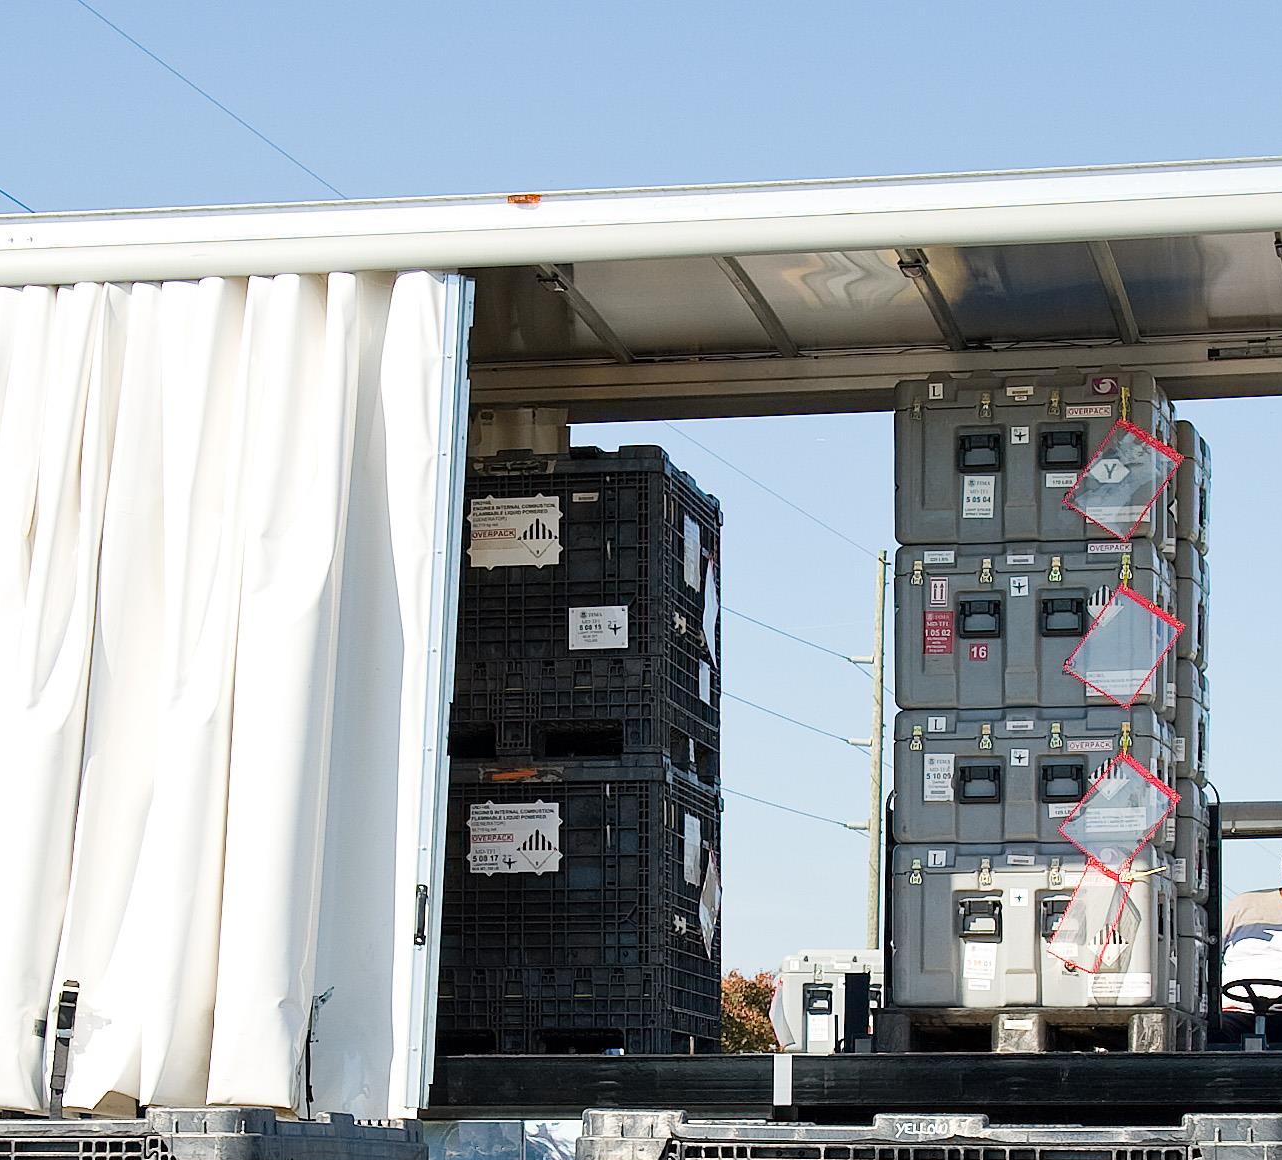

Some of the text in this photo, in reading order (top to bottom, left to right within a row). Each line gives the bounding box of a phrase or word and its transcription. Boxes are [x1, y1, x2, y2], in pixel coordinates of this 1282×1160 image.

[932, 386, 939, 397] L
[1068, 407, 1111, 417] OVERPACK
[1104, 463, 1116, 479] Y
[472, 530, 515, 539] OVERPACK
[1089, 544, 1130, 552] OVERPACK
[971, 647, 987, 658] 16
[933, 720, 942, 731] L
[1070, 741, 1111, 750] OVERPACK
[472, 834, 513, 842] OVERPACK
[933, 852, 941, 865] L
[895, 1122, 948, 1139] YELLOW
